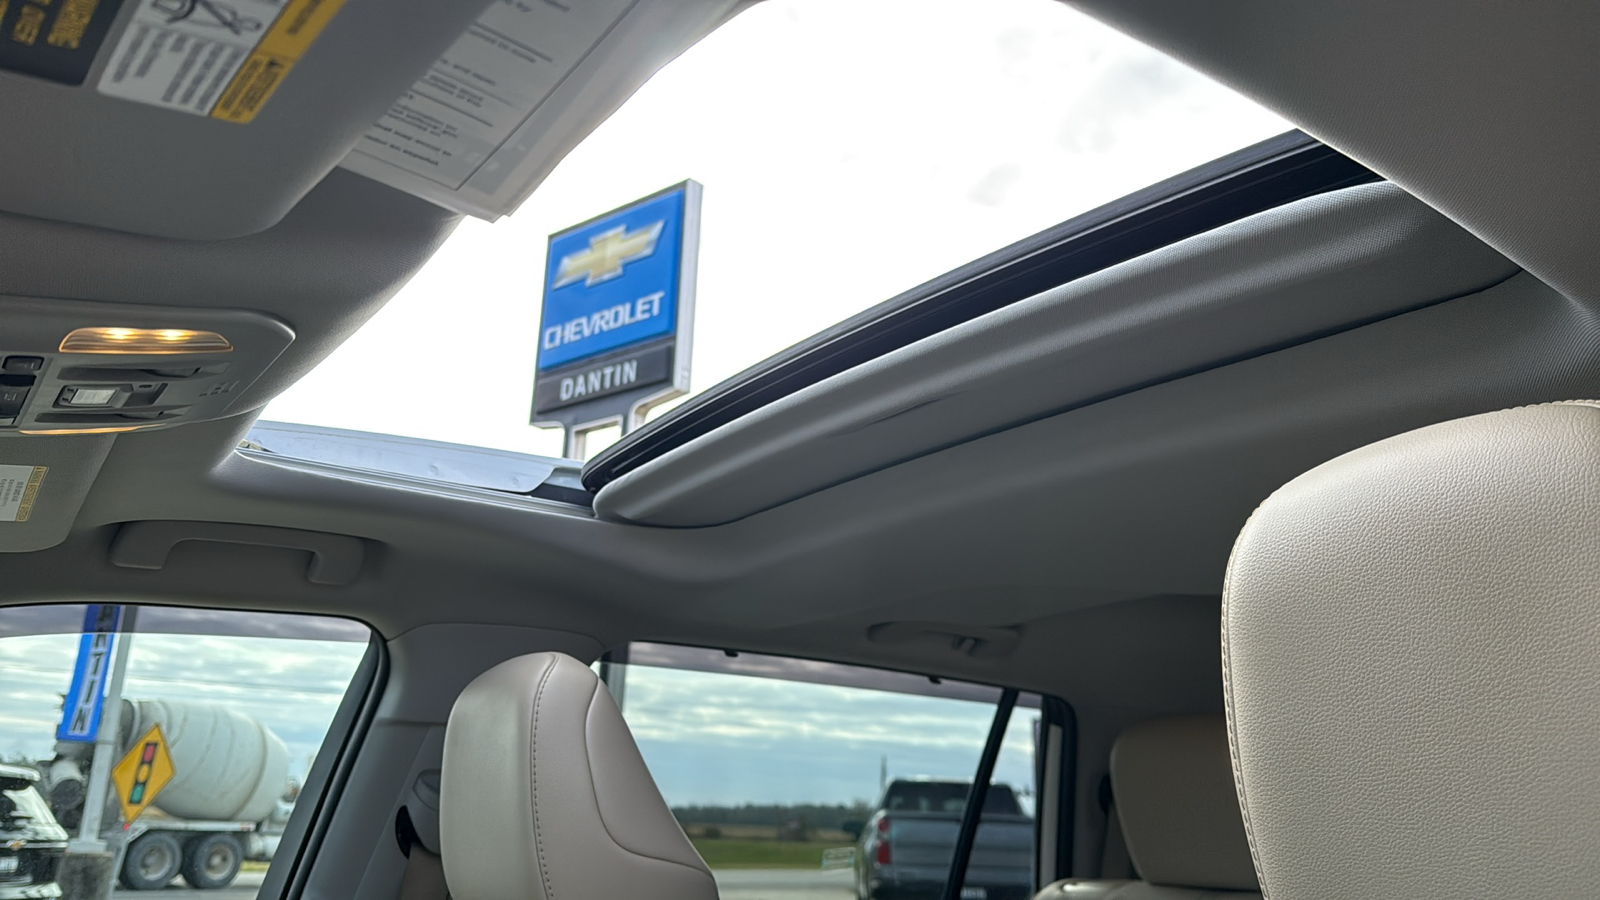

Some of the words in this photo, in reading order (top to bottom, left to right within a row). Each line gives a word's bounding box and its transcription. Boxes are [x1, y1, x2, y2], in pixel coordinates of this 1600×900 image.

[544, 291, 664, 350] CHEVROLET
[560, 360, 637, 400] DANTIN
[72, 605, 113, 731] ANTIN
